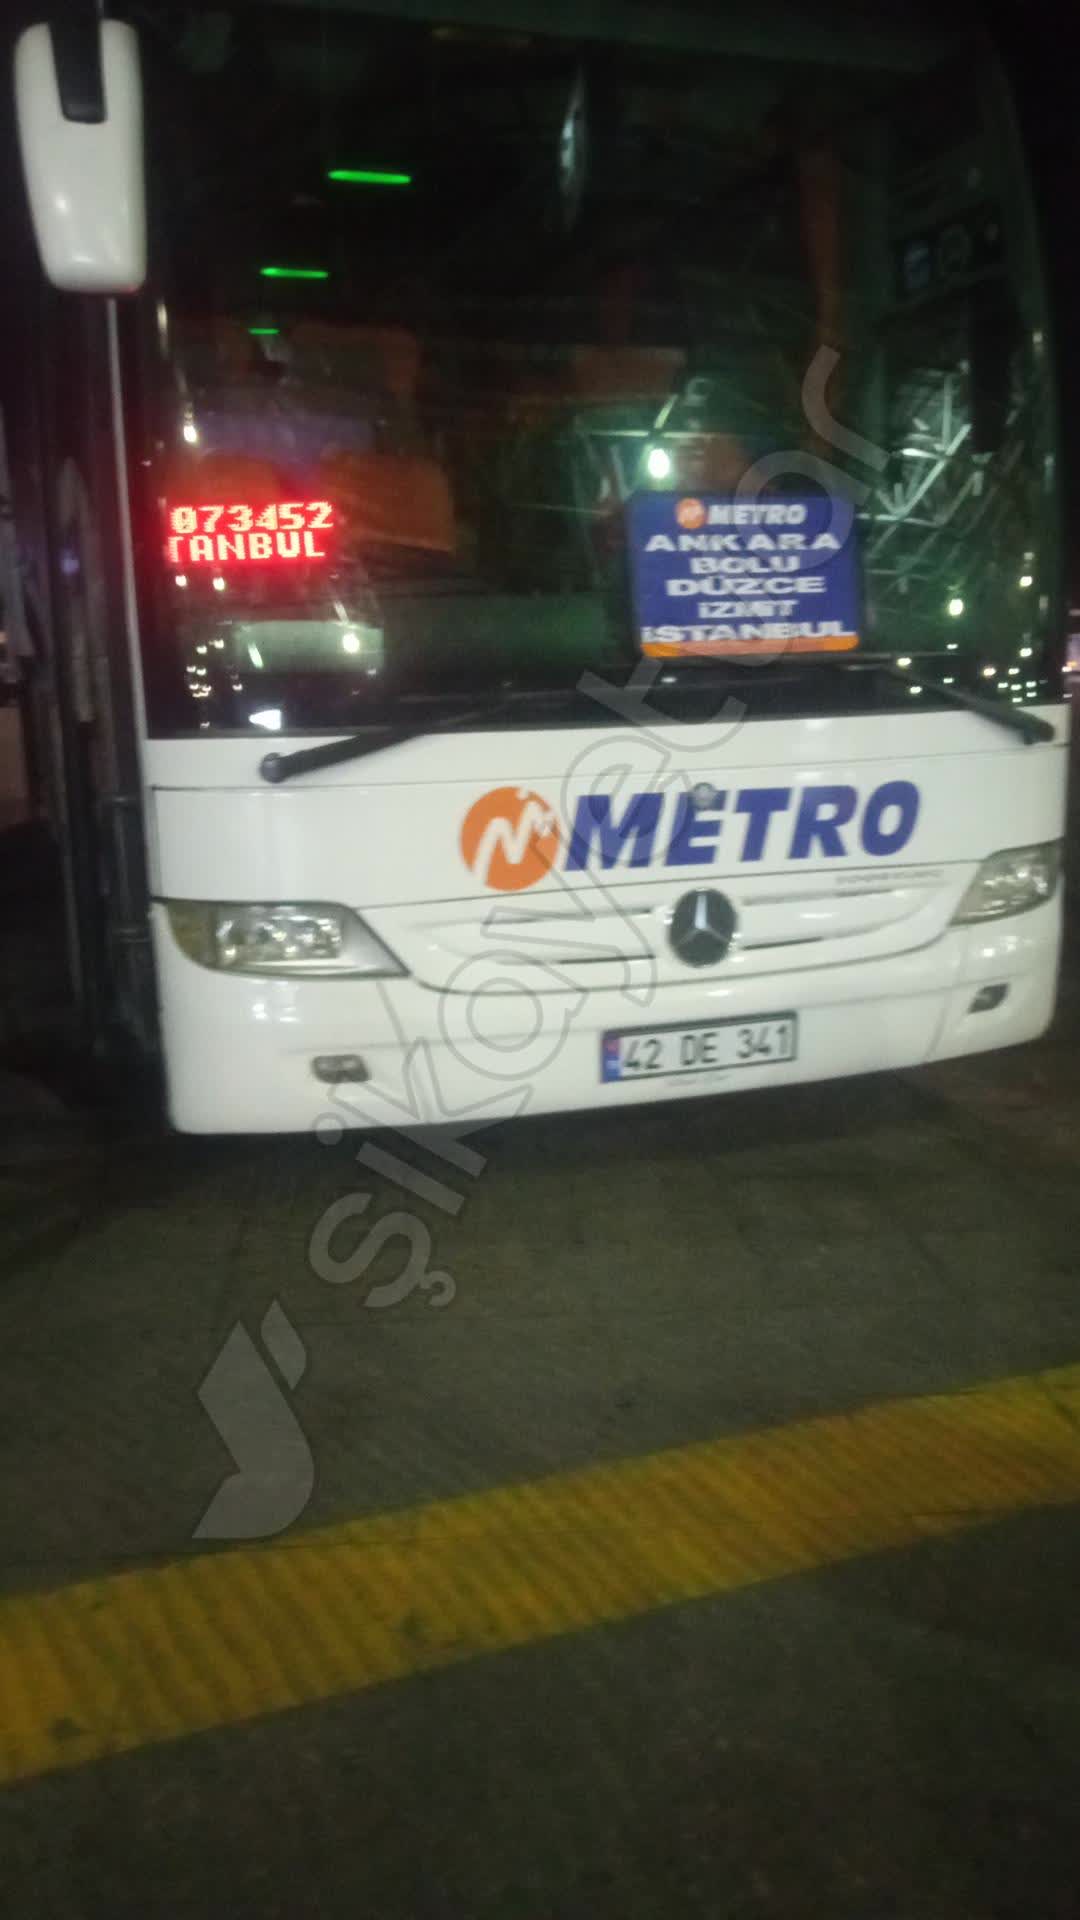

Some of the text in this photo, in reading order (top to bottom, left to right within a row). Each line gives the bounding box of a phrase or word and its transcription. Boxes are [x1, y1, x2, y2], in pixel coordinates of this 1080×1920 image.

[170, 501, 334, 534] 073452
[707, 504, 807, 525] METRO
[644, 533, 843, 552] ANKARA
[689, 555, 800, 575] BOLU
[665, 576, 828, 596] DÜZCE
[562, 780, 920, 872] METRO
[622, 1024, 788, 1070] 42 DE 341
